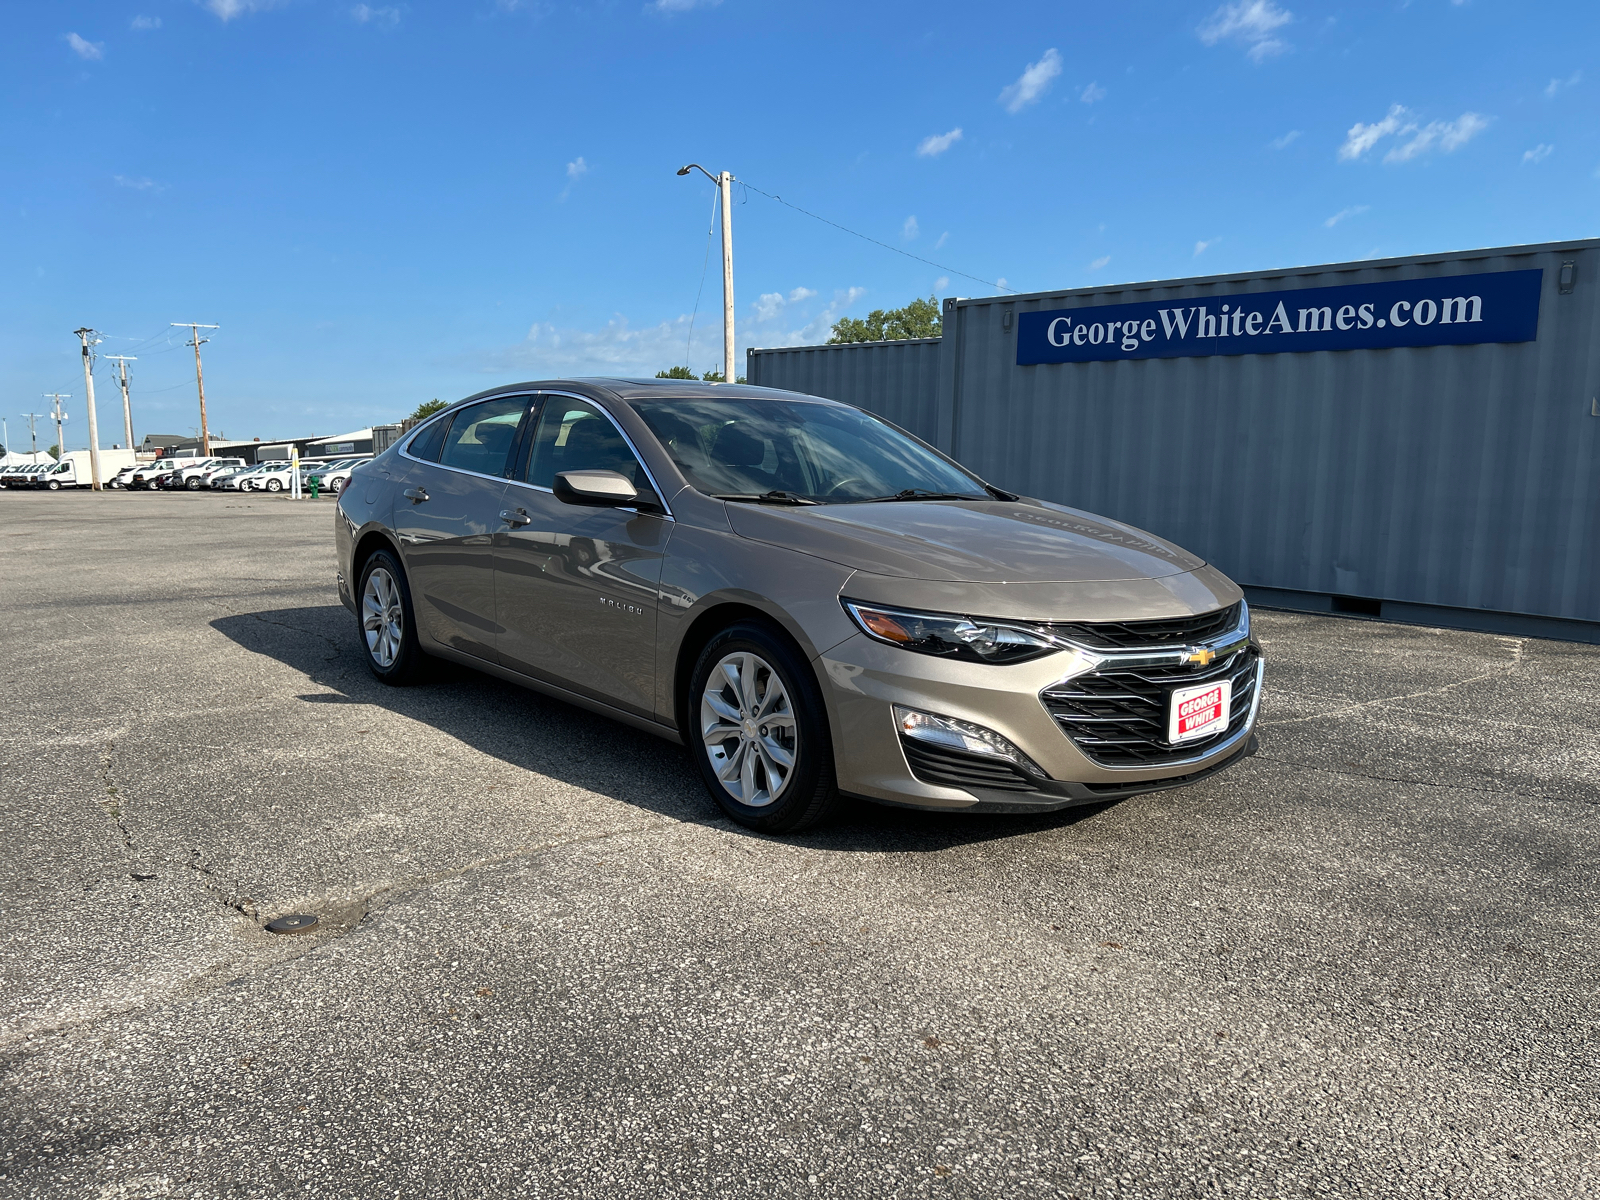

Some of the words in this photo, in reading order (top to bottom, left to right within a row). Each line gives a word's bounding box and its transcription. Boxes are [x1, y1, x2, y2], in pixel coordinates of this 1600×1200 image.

[1047, 295, 1483, 351] GeorgeWhiteAmes.com
[600, 597, 643, 615] MALIBU
[1180, 689, 1219, 716] GEORGE
[1185, 707, 1215, 731] WHITE
